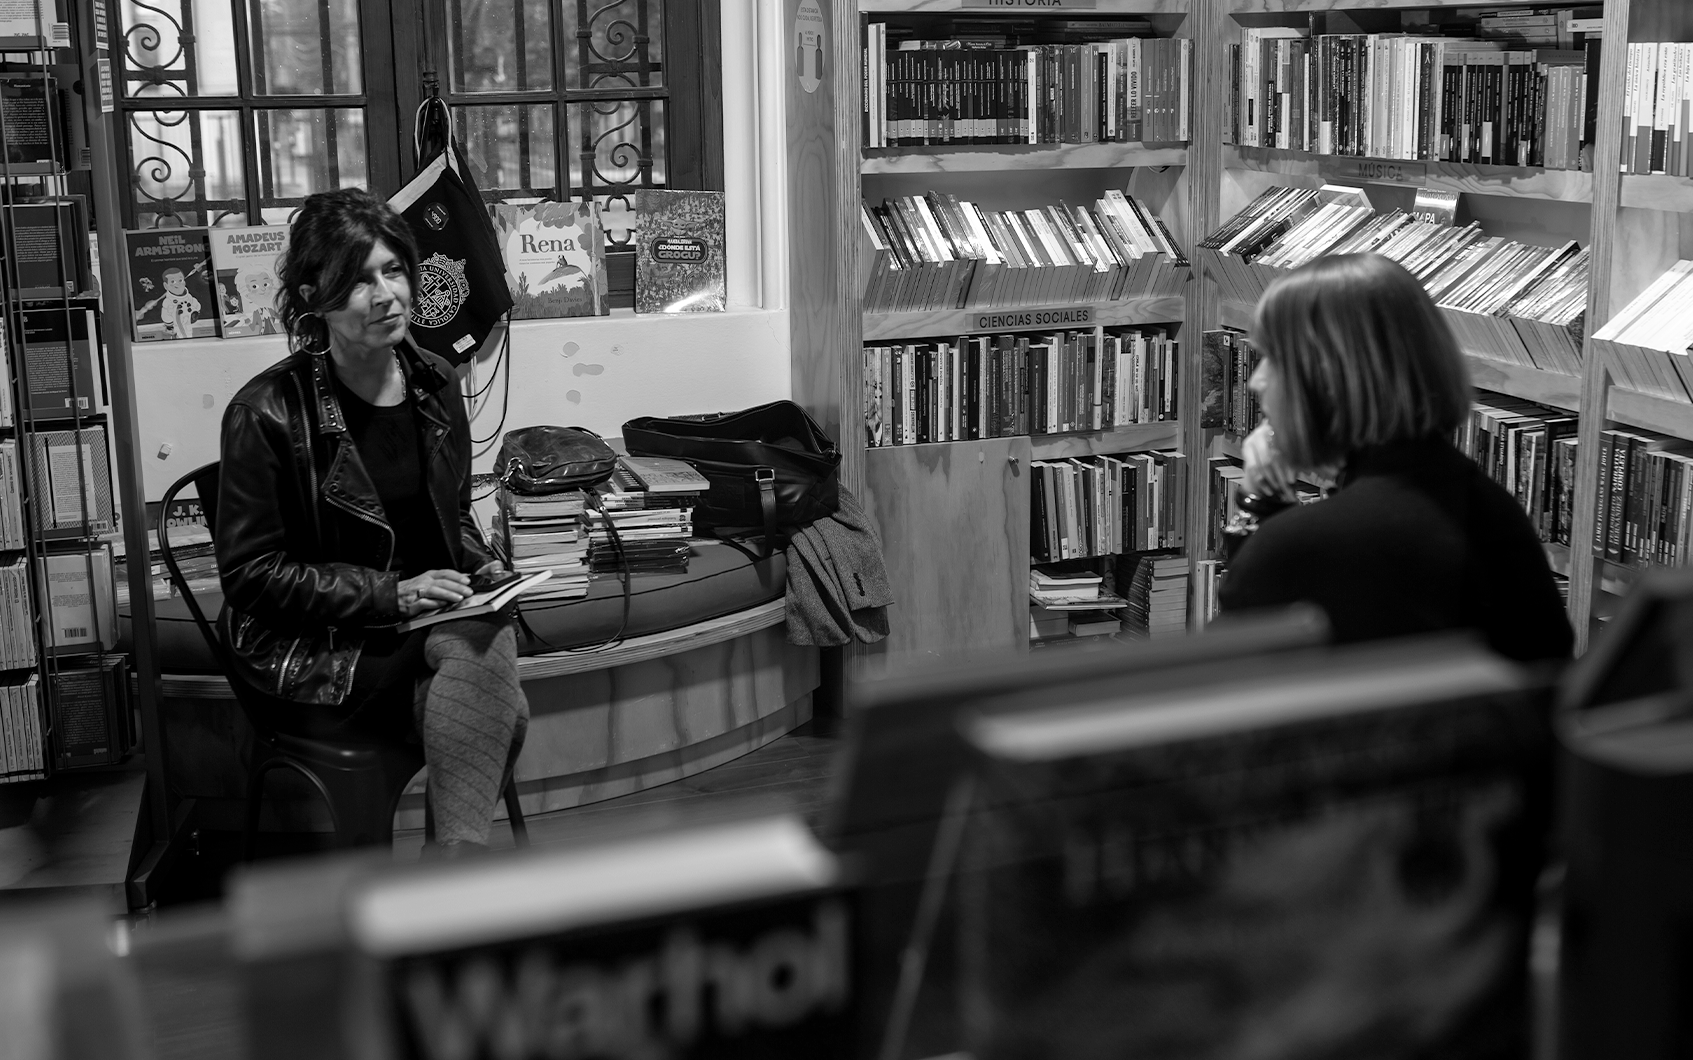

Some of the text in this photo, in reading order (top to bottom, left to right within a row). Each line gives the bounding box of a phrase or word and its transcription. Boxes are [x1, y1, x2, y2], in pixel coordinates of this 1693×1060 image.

[1358, 162, 1404, 182] MÚSICA
[227, 232, 285, 244] AMADEUS
[520, 234, 576, 254] Rena
[232, 242, 282, 254] MOZART
[658, 251, 701, 260] GROGU?
[429, 266, 459, 302] UNIVERSIDAD
[548, 296, 562, 305] Benji
[979, 310, 1089, 329] CIENCIAS SOCIALES
[173, 504, 203, 516] J. K.
[404, 899, 853, 1060] Warhol
